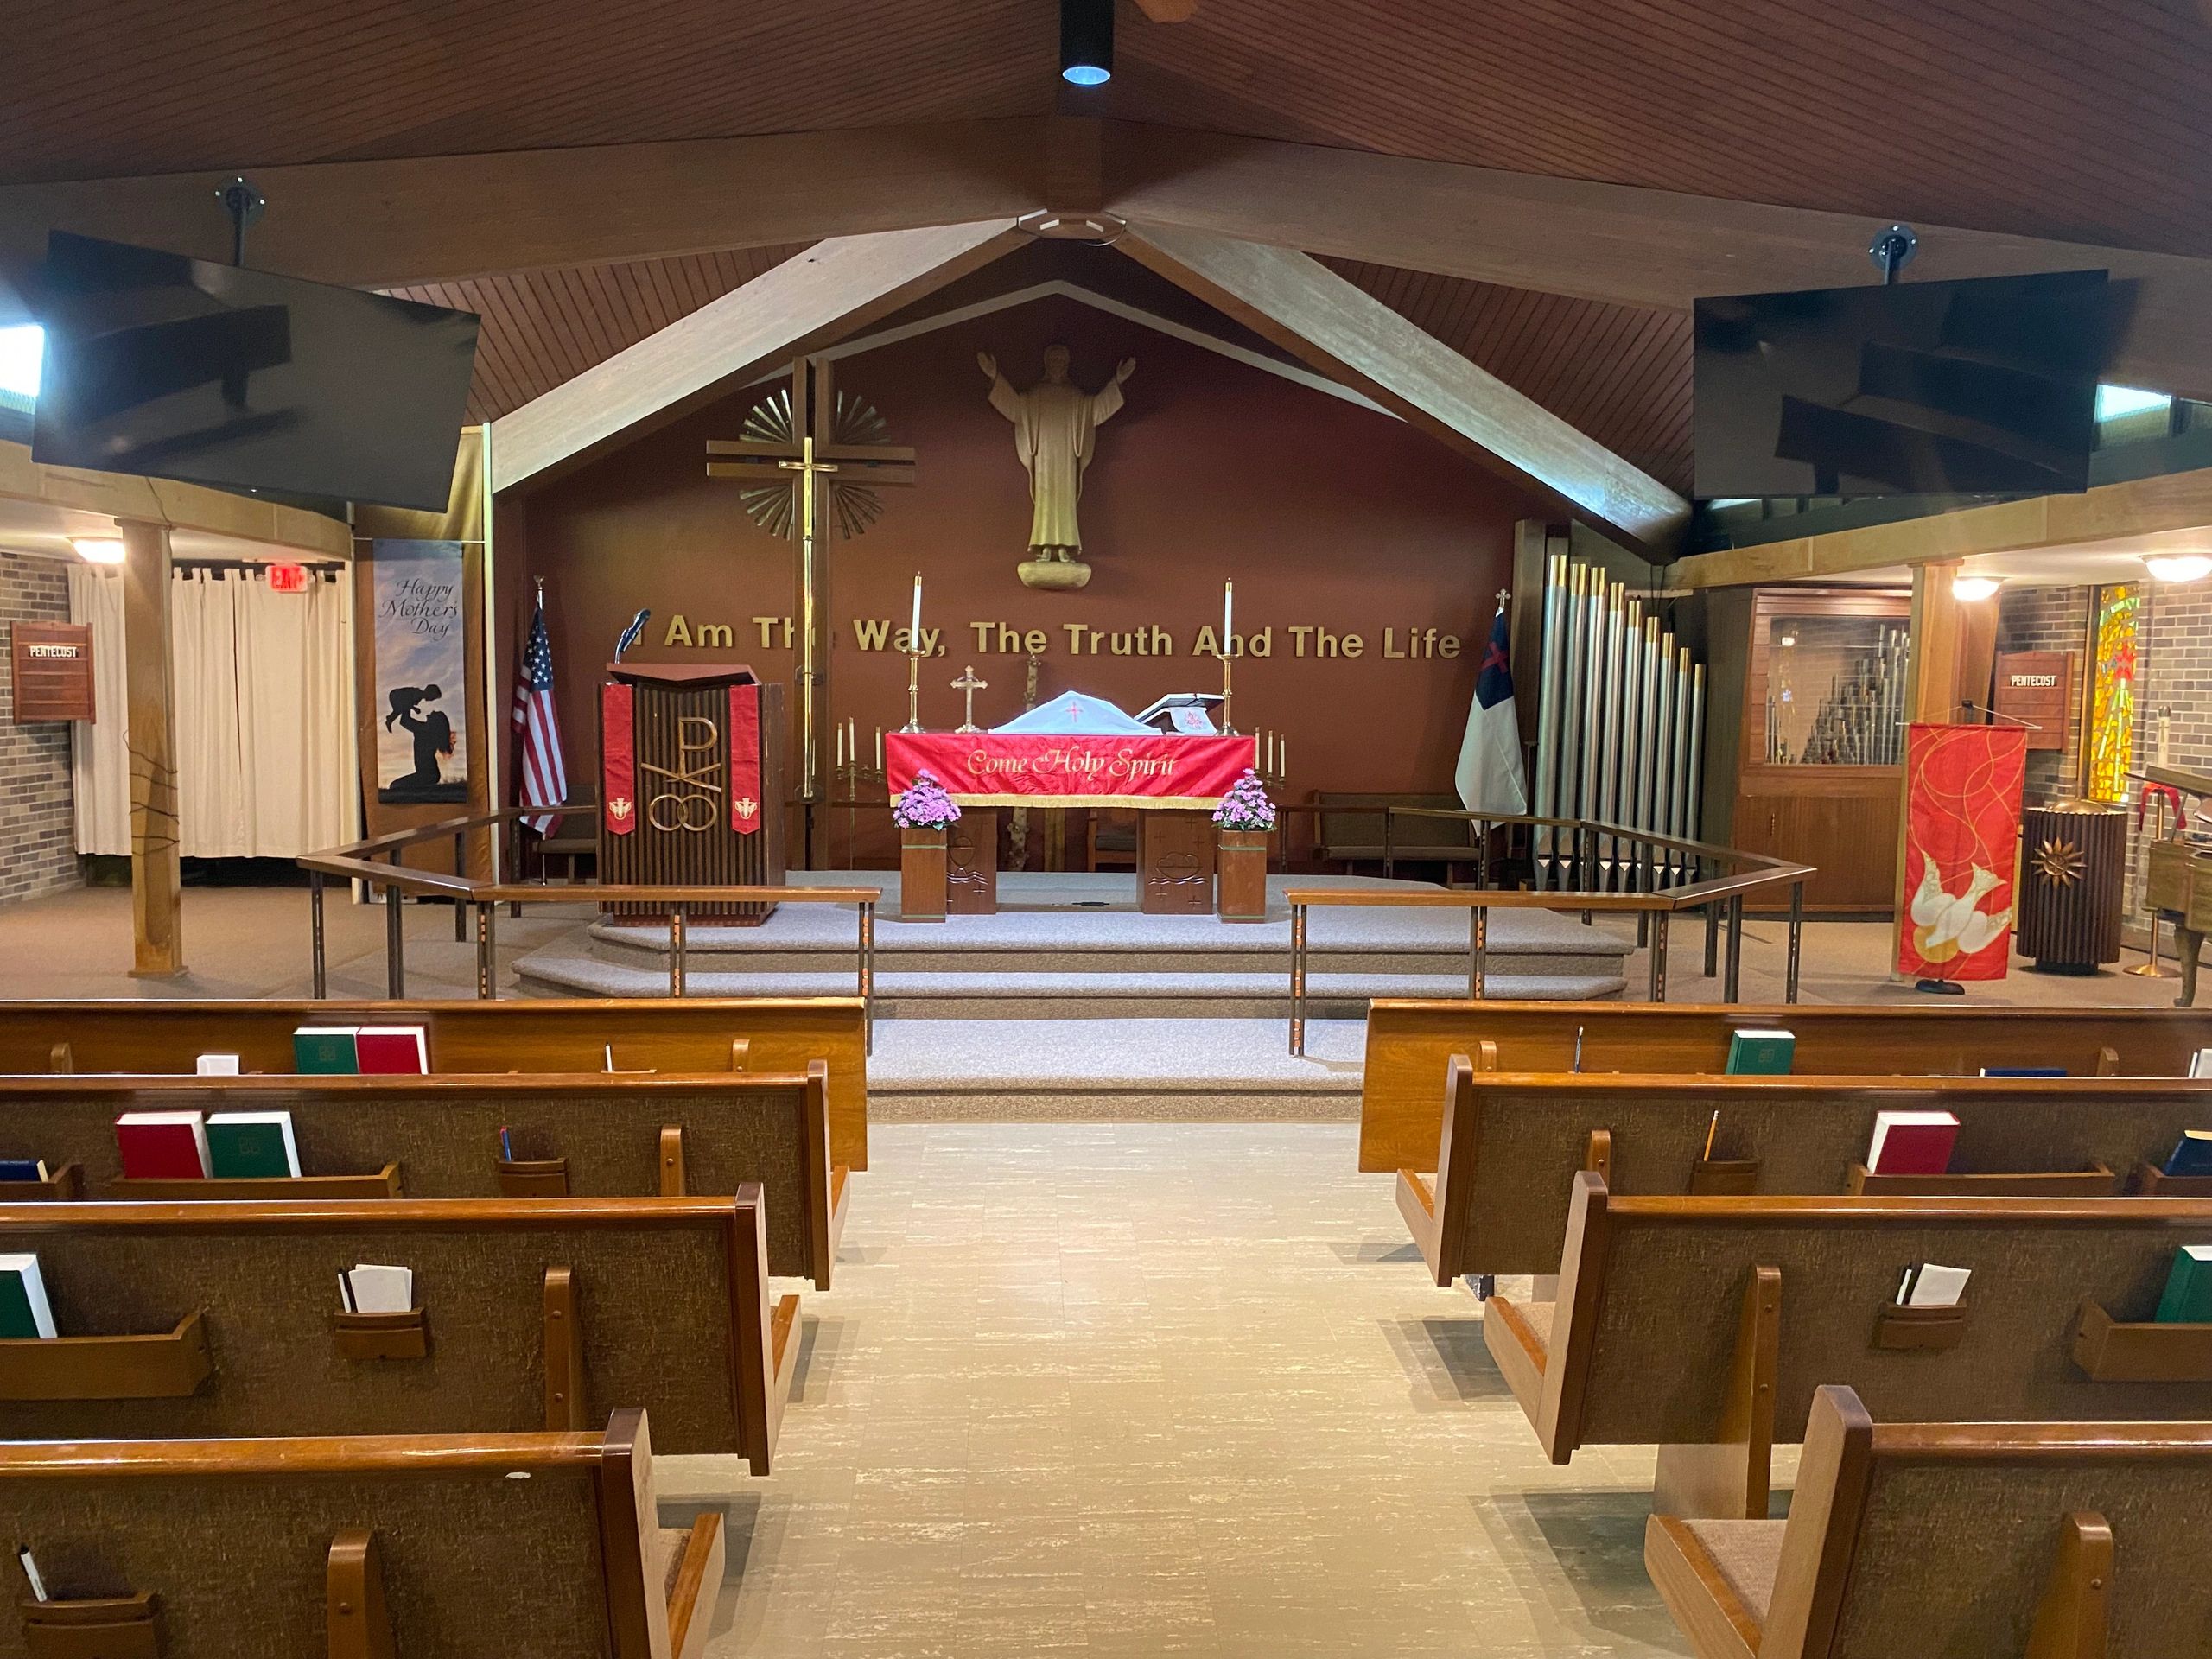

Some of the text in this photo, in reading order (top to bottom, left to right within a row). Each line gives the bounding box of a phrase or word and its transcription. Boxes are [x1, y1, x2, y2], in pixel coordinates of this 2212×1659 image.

[396, 578, 454, 602] Happy
[378, 599, 458, 619] Mother's
[411, 617, 450, 641] Day
[664, 614, 733, 647] Am
[753, 616, 816, 649] Th
[853, 620, 945, 658] Way,
[969, 621, 1047, 654] The
[1063, 623, 1173, 656] Truth
[1192, 626, 1272, 658] And
[1287, 626, 1363, 658] The
[1383, 627, 1460, 658] Life
[29, 645, 77, 658] PENTECOST
[2011, 675, 2056, 687] PENTECOST
[967, 746, 1177, 781] Come Holy Spirit
